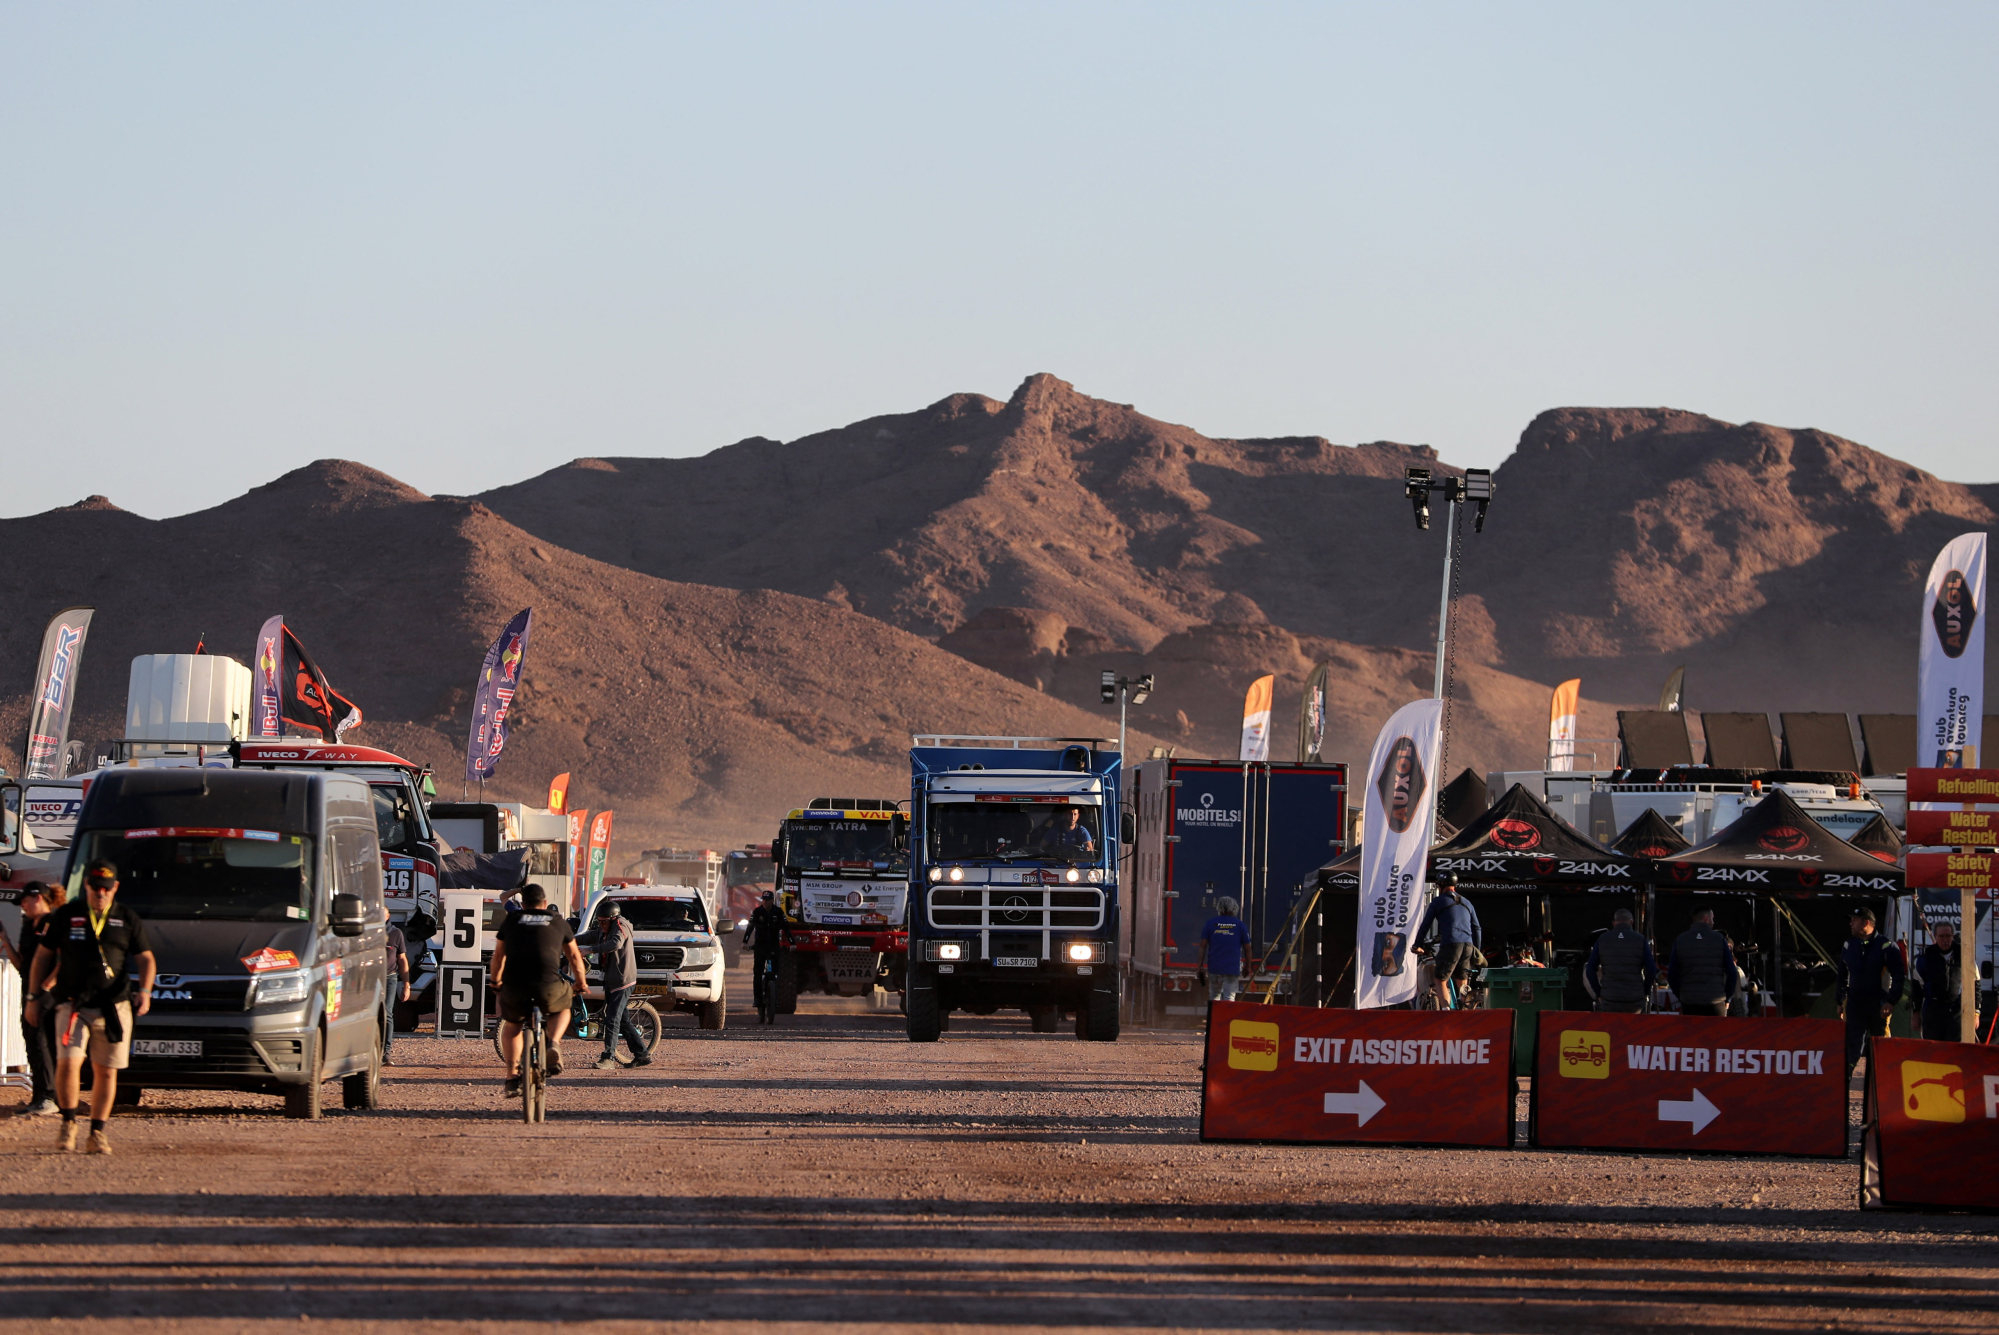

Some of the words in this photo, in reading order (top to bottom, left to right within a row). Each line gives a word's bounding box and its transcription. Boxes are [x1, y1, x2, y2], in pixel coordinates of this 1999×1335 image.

[1946, 578, 1961, 648] AUXOL
[44, 624, 83, 712] BBR
[1947, 687, 1958, 743] aventura
[1955, 695, 1970, 746] touareg
[1936, 717, 1947, 746] club
[1391, 745, 1412, 824] AUXOL
[828, 822, 868, 831] TATRA
[1950, 812, 1990, 827] Water
[1942, 829, 1997, 844] Restock
[1434, 858, 1508, 872] 24MX
[1558, 861, 1631, 877] 24MX
[1697, 867, 1771, 883] 24MX
[1947, 855, 1991, 872] Safety
[1822, 874, 1898, 891] 24MX
[1947, 872, 1992, 887] Center
[1386, 864, 1400, 926] aventura
[1396, 873, 1414, 929] touareg
[1375, 896, 1387, 928] club
[453, 908, 475, 949] 5
[831, 969, 872, 978] TATRA
[150, 990, 192, 999] MAN
[451, 969, 474, 1010] 5
[178, 1042, 200, 1054] 333
[1294, 1036, 1346, 1063] EXIT
[1349, 1038, 1491, 1065] ASSISTANCE
[1627, 1044, 1710, 1073] WATER
[1715, 1048, 1824, 1075] RESTOCK
